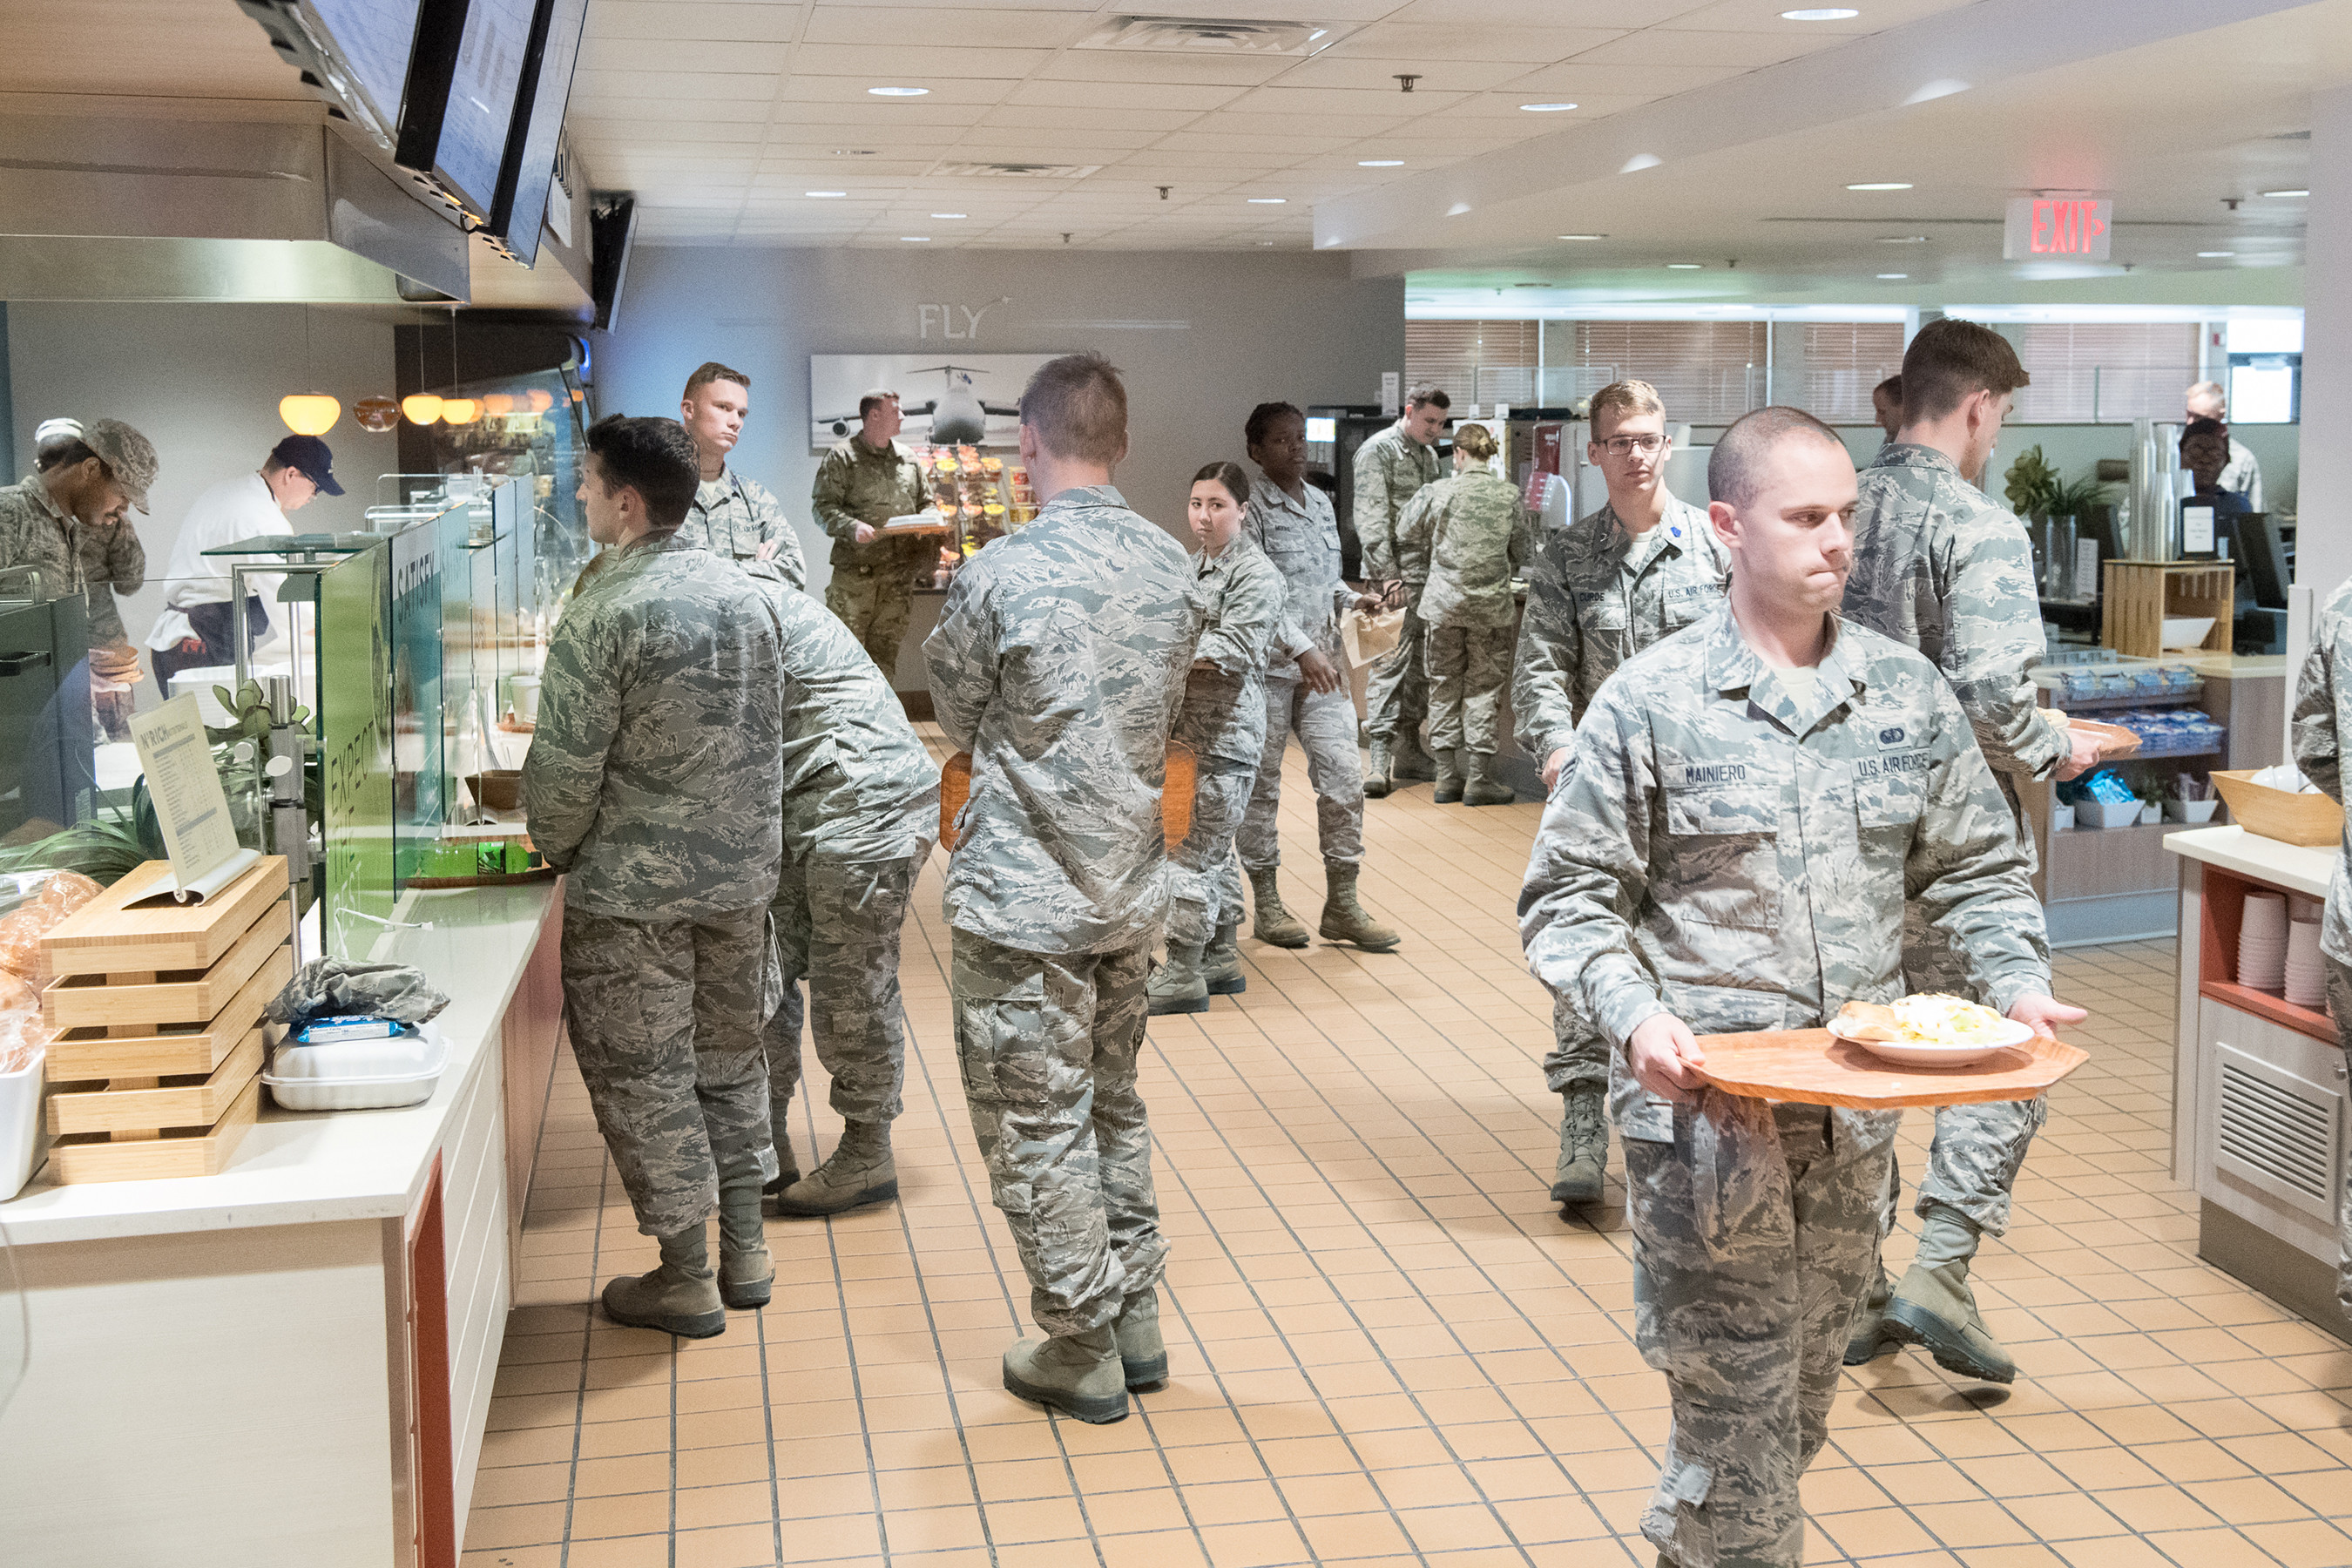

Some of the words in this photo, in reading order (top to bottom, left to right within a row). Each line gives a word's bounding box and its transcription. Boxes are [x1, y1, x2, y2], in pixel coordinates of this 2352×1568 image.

[2031, 199, 2097, 253] EXIT
[918, 304, 991, 339] FLY
[397, 550, 435, 625] SATISFY
[1668, 588, 1683, 598] U.S.
[1686, 585, 1697, 597] AIR
[331, 719, 374, 818] EXPECT
[1686, 765, 1746, 784] MAINIERO
[1858, 760, 1880, 776] U.S.
[1882, 755, 1901, 774] AIR
[334, 805, 355, 883] THE
